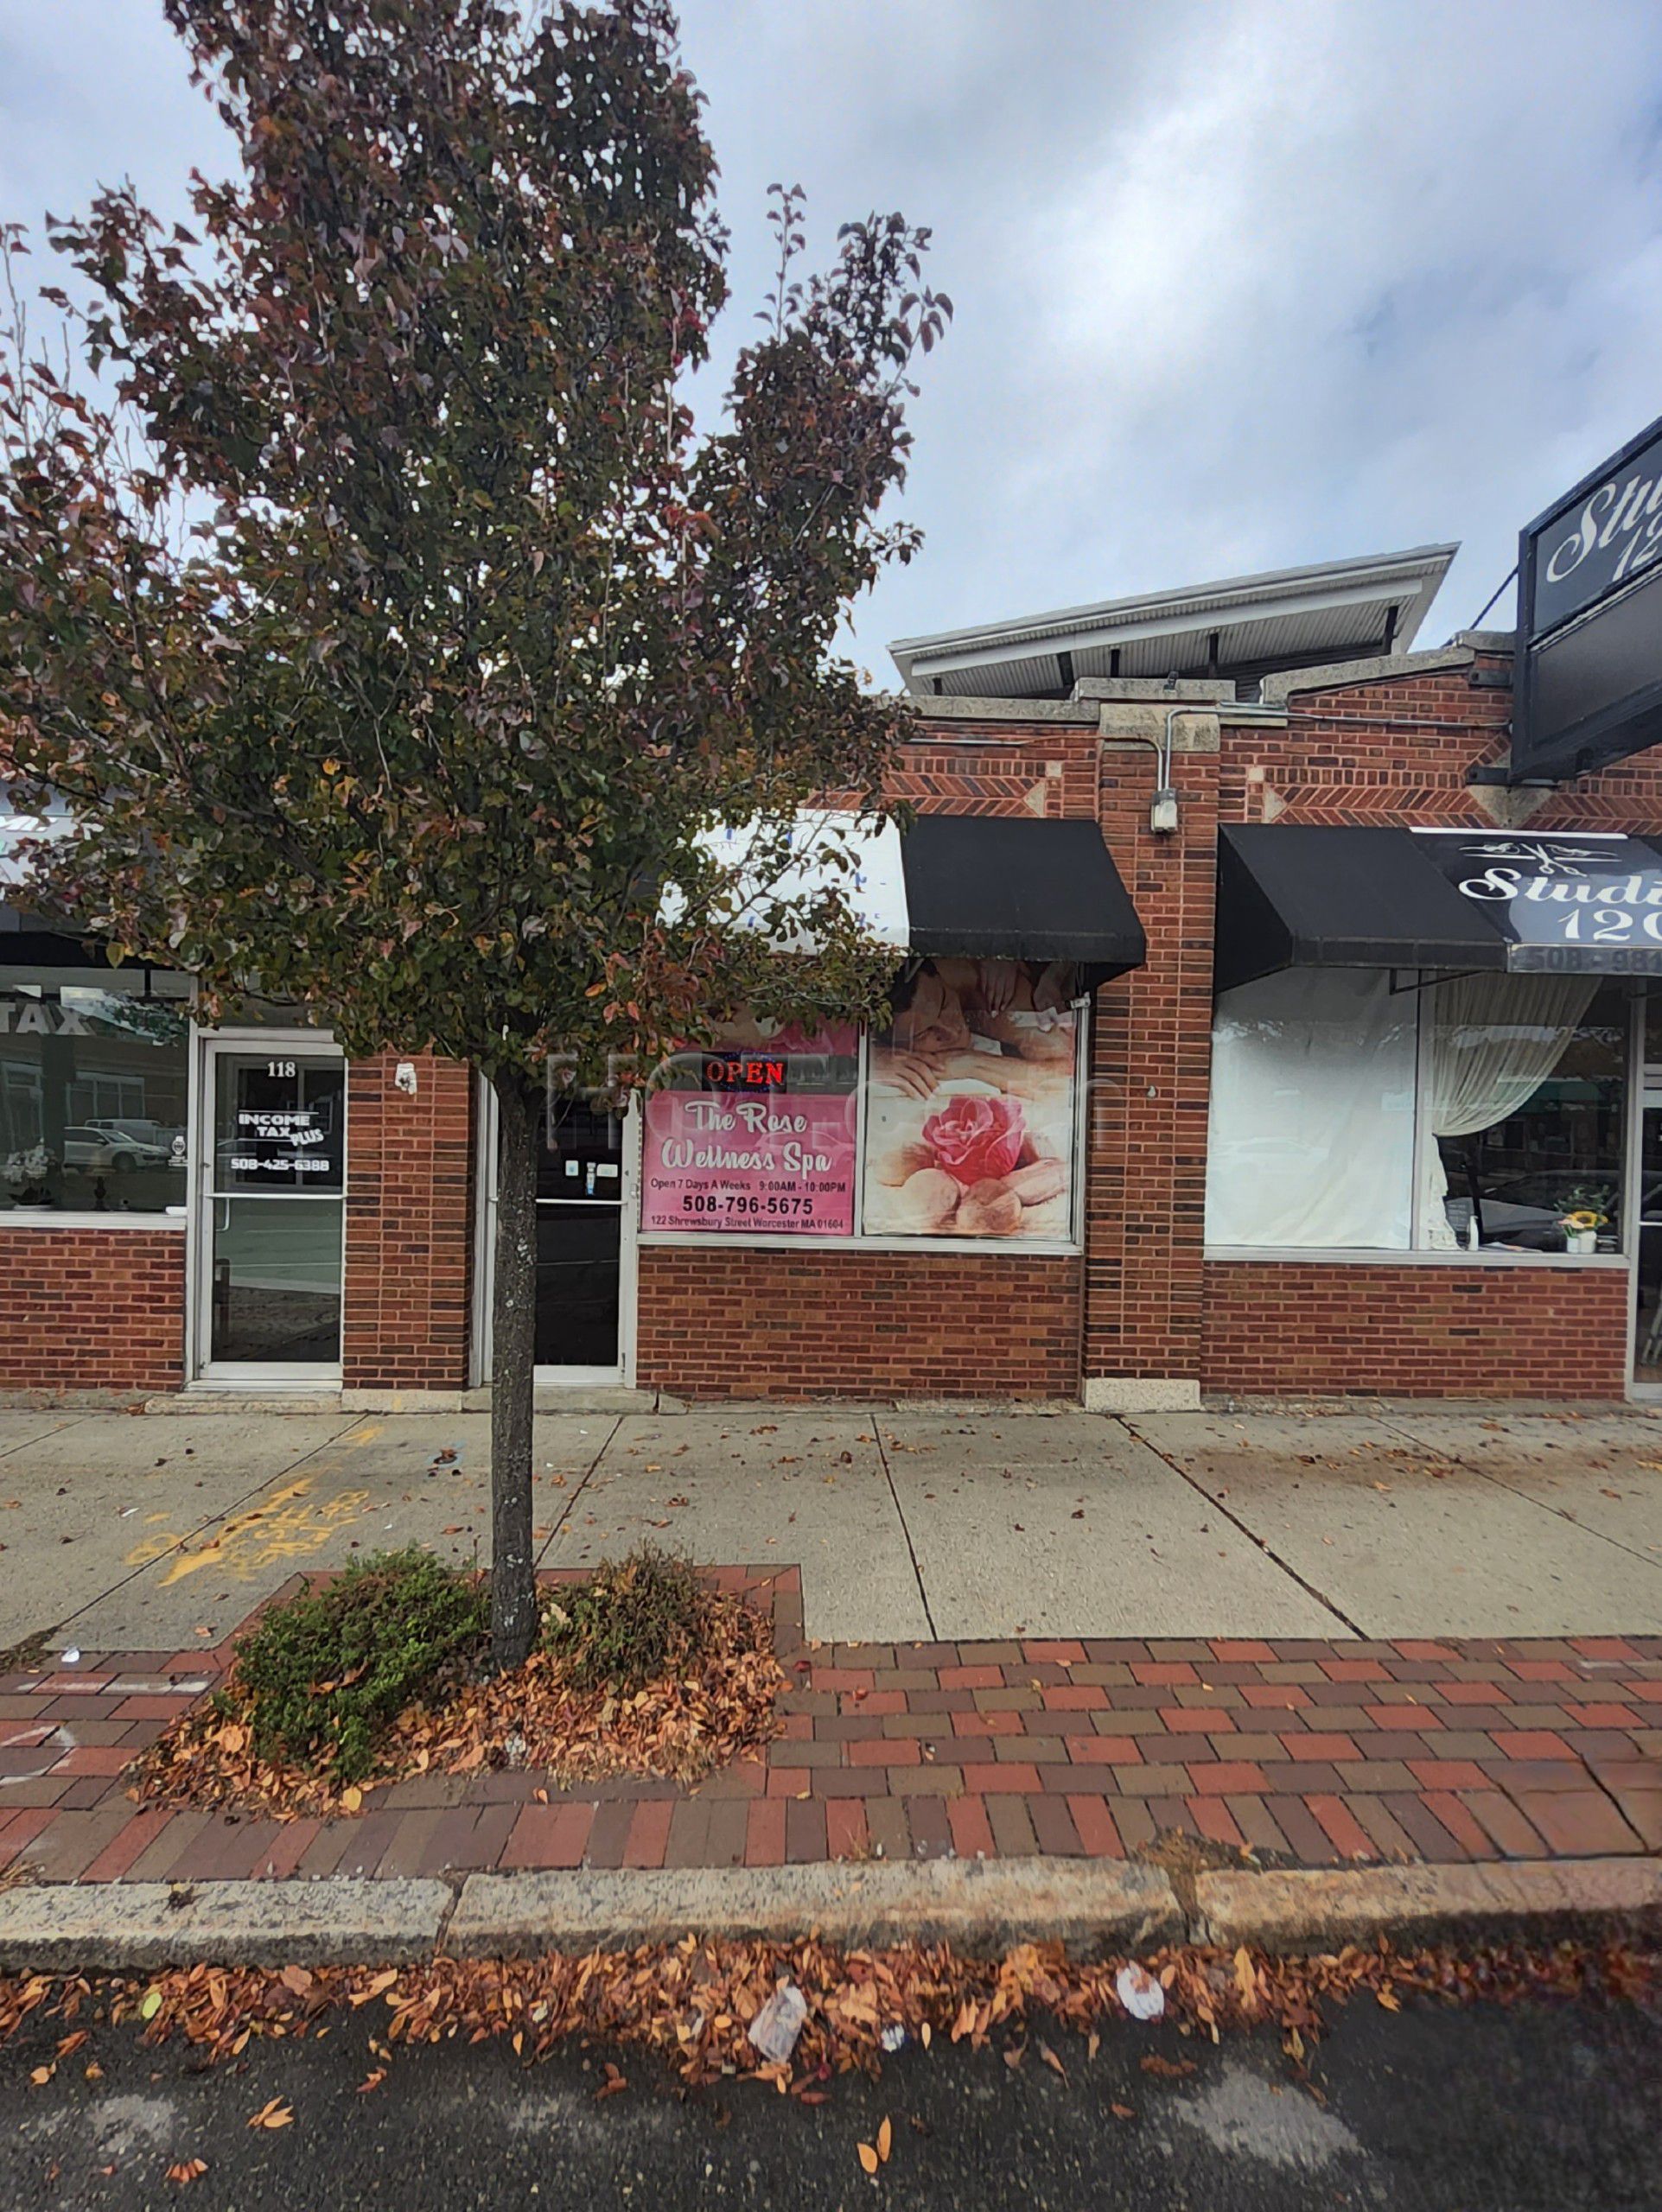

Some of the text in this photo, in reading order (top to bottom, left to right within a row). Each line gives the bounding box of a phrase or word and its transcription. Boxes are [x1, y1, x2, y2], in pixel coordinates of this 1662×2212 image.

[0, 1002, 90, 1035] TAX
[267, 1061, 296, 1077] 118
[705, 1061, 784, 1084] OPEN
[239, 1114, 310, 1126] INCOME
[685, 1100, 807, 1134] The Rose
[257, 1126, 324, 1147] TAX PLUS
[661, 1137, 832, 1179] Wellness Spa
[650, 1178, 676, 1191] Open
[678, 1179, 684, 1189] 7
[685, 1179, 709, 1192] Days
[710, 1180, 719, 1190] A
[720, 1181, 751, 1191] Weeks
[759, 1181, 796, 1192] 9:00AM
[805, 1183, 846, 1192] 10:00PM
[683, 1195, 813, 1215] 508-796-5675
[651, 1216, 666, 1225] 122
[668, 1217, 722, 1230] Shrewsbury
[724, 1217, 752, 1228] Street
[754, 1218, 799, 1229] Worcester
